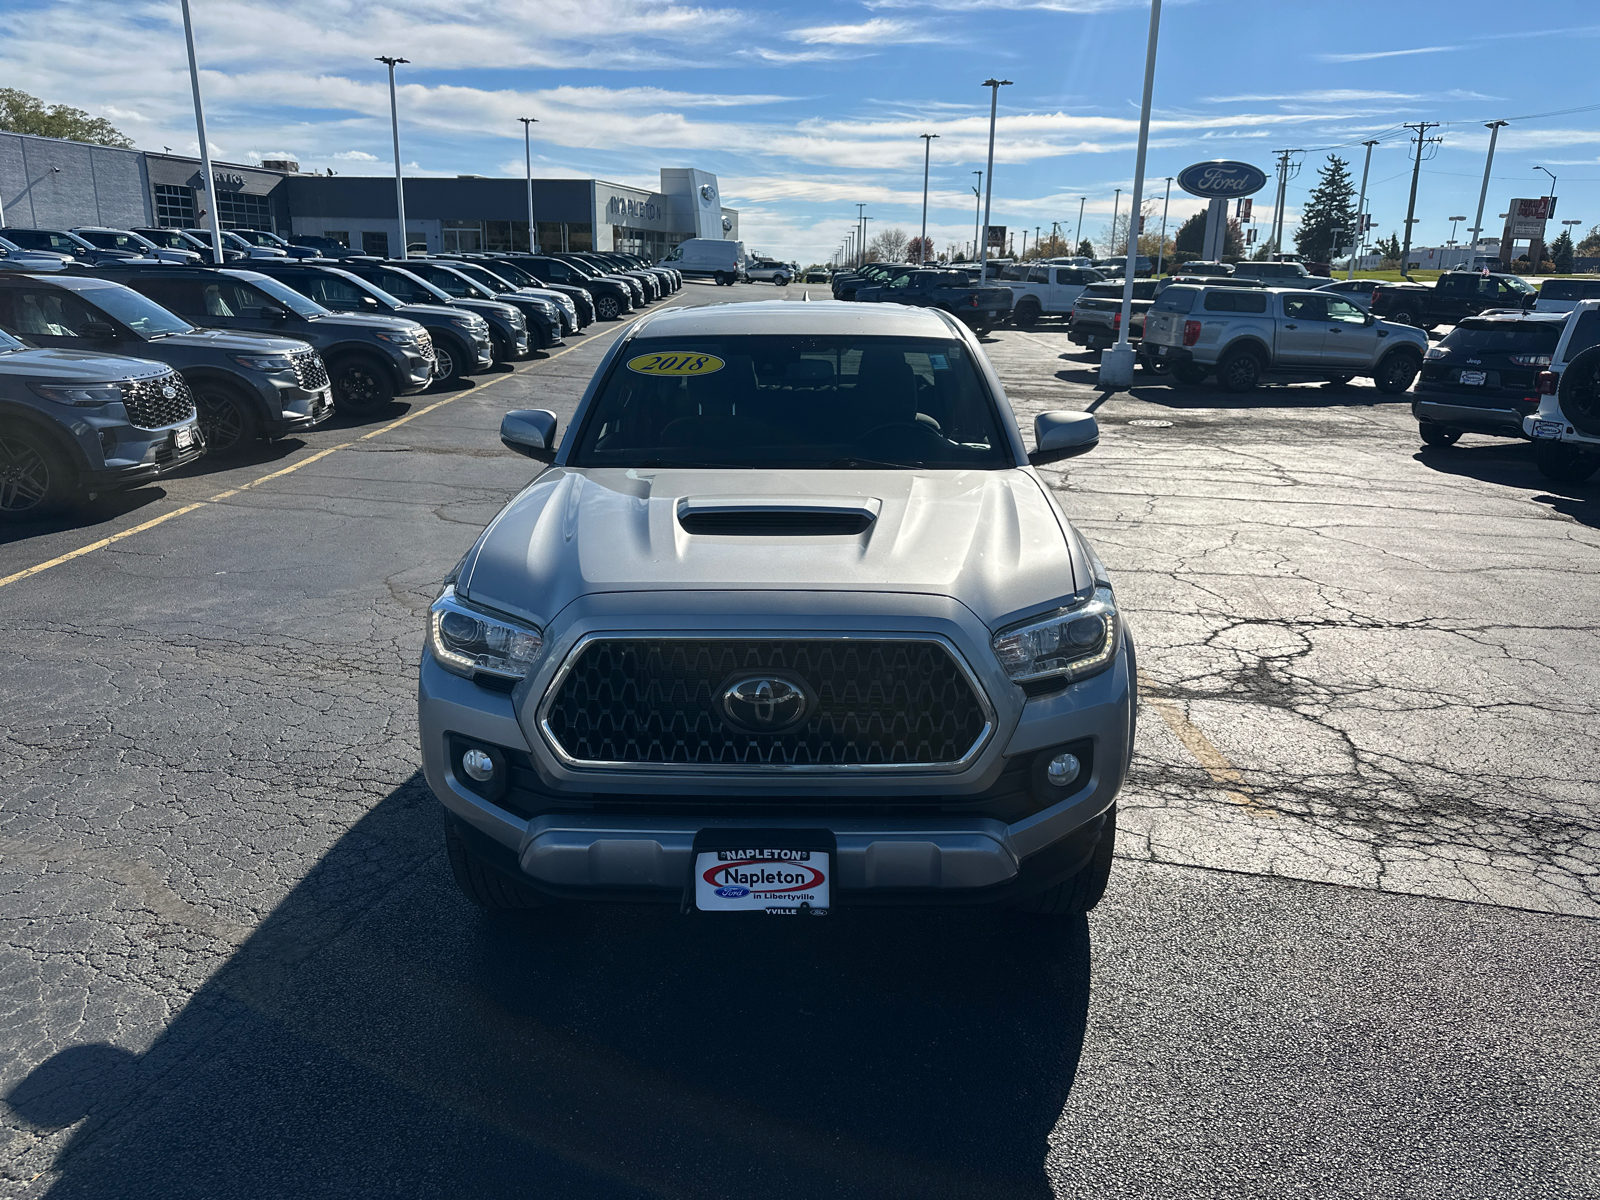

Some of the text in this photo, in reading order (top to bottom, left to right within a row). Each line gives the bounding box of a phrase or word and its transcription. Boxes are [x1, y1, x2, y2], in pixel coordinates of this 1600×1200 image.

[199, 170, 248, 185] SRVICE
[1198, 168, 1249, 189] Ford
[610, 196, 661, 220] NAPLETON
[640, 356, 709, 371] 2018
[1466, 357, 1482, 365] Jeep
[726, 849, 801, 860] NAPLETON
[724, 868, 805, 887] Napleton
[721, 887, 743, 897] Ford
[764, 893, 815, 901] Libertyville
